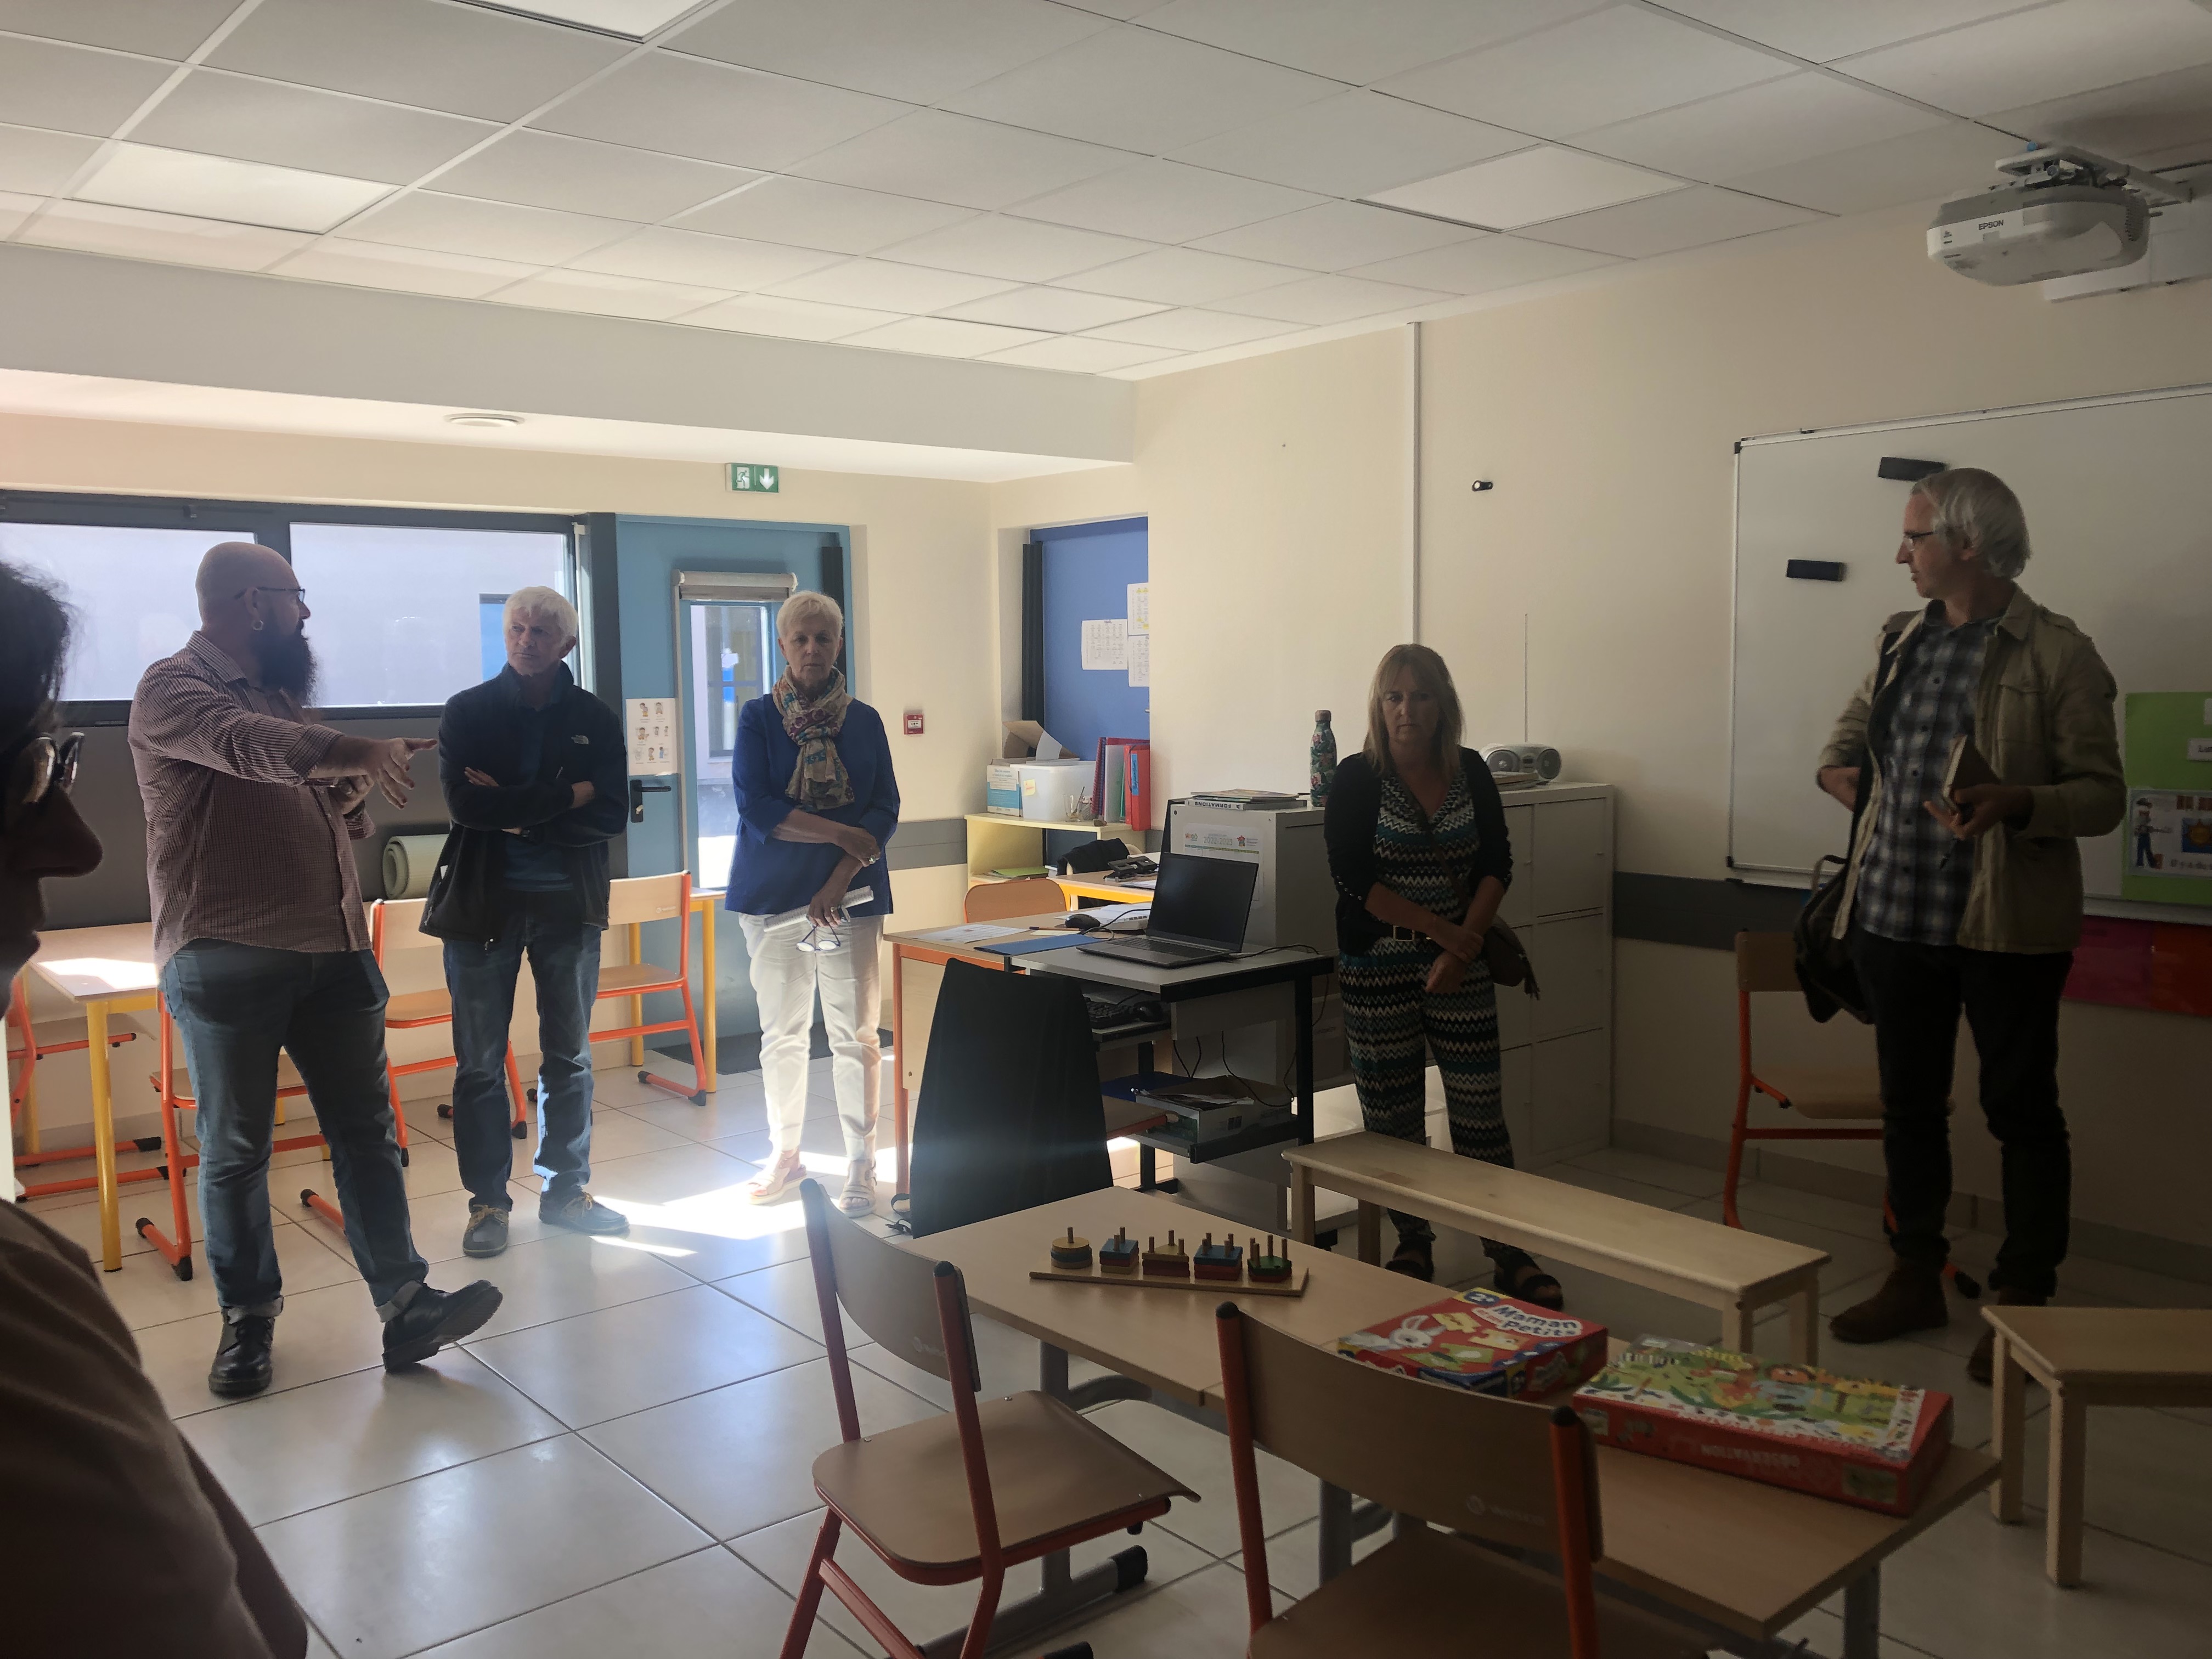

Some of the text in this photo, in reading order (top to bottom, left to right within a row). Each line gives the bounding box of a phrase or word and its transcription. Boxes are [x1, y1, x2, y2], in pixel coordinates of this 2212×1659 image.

[1978, 219, 2004, 230] EPSON
[1204, 836, 1233, 846] 2022-2023
[1492, 1306, 1577, 1328] Maman
